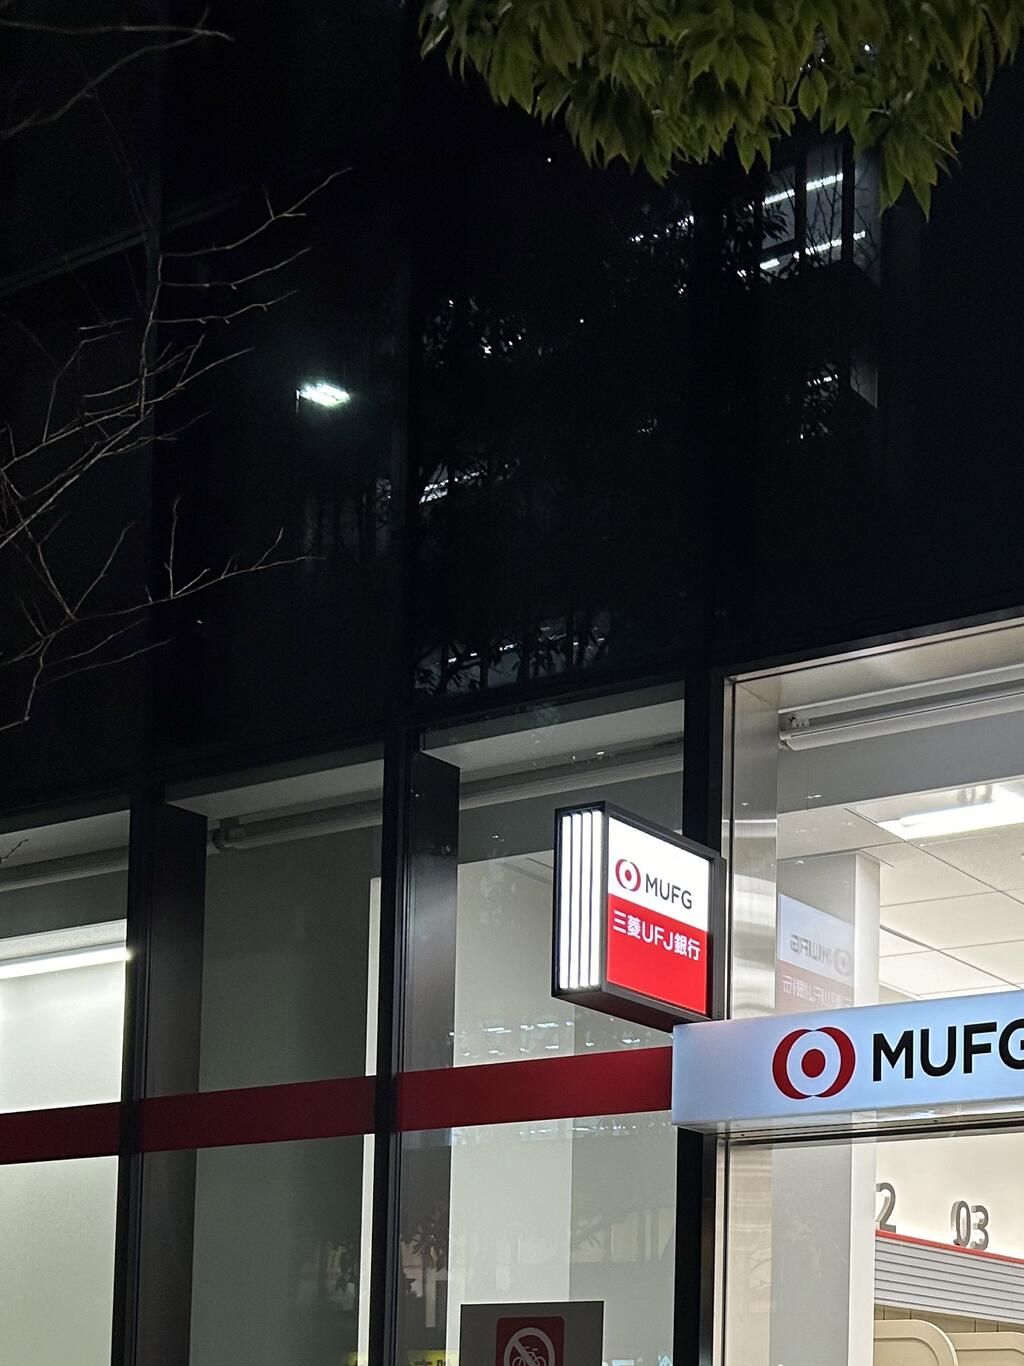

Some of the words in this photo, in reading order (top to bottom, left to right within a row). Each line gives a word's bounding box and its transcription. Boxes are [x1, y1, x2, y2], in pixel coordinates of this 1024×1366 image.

[645, 873, 692, 910] MUFG
[613, 910, 701, 961] 三菱UFJ銀行
[876, 1182, 897, 1233] 2
[951, 1200, 989, 1250] 03
